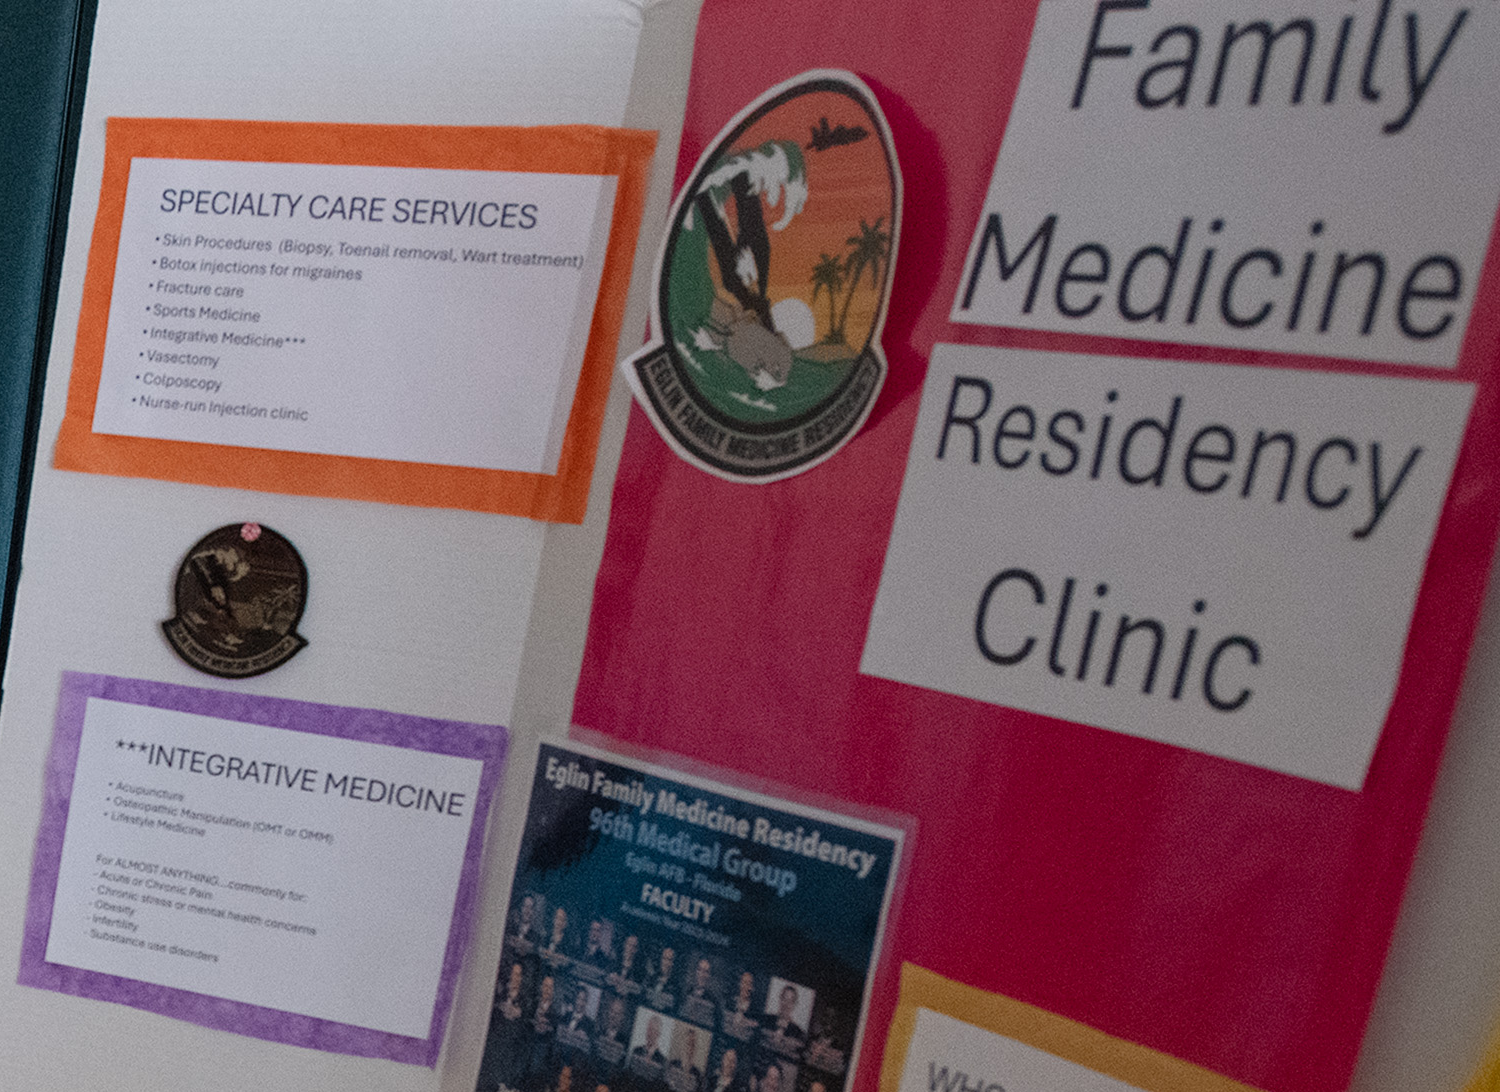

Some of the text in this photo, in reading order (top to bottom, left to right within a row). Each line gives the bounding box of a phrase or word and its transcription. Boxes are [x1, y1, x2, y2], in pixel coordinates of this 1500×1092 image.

[1070, 0, 1471, 135] Family
[160, 189, 539, 229] SPECIALTY CARE SERVICES
[163, 233, 584, 270] Skin Procedures (Biopsy, Toenail removal, Wart treatment)
[159, 257, 363, 282] Botox injections for migraines
[959, 212, 1465, 341] Medicine
[156, 281, 245, 298] Fracture care
[153, 303, 261, 322] Sports Medicine
[150, 327, 218, 344] Integrative
[147, 350, 220, 369] Vasectomy
[143, 372, 222, 392] Colposcopy
[140, 395, 309, 421] Nurse-run Injection clinic
[934, 375, 1424, 540] Residency
[971, 568, 1265, 714] Clinic
[115, 782, 185, 801] Acupuncture
[324, 772, 466, 817] MEDICINE
[111, 812, 206, 837] Lifestyle Medicine
[113, 797, 177, 816] Osteopathic
[180, 808, 251, 828] Manipulation
[285, 829, 298, 837] or
[545, 757, 877, 880] Eglin Family Medicine Residency
[96, 854, 112, 865] For
[114, 858, 159, 874] ALMOST
[589, 807, 799, 897] 96th Medical Group
[625, 851, 657, 874] Eglin
[100, 871, 214, 900] Acute or Chronic Pain
[94, 900, 135, 916] Obesity
[97, 885, 137, 900] Chronic
[174, 901, 186, 910] or
[227, 911, 263, 925] health
[264, 918, 317, 936] concerns
[641, 884, 715, 923] FACULTY
[92, 914, 139, 932] Infertility
[90, 928, 219, 963] Substance use disorders
